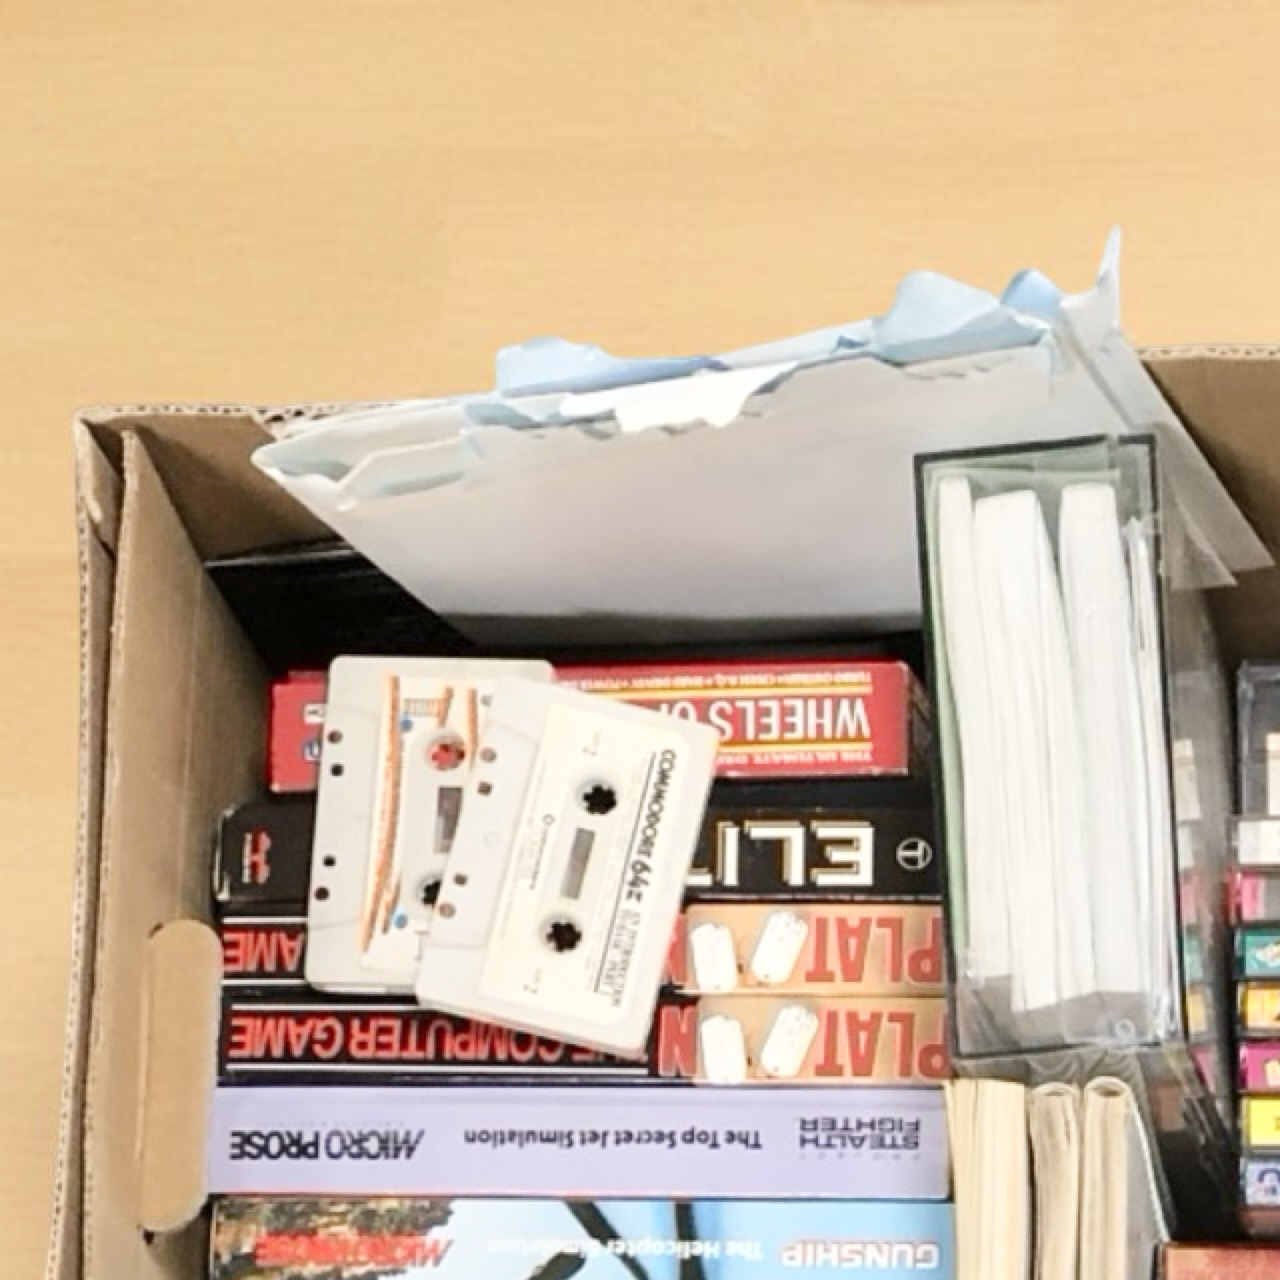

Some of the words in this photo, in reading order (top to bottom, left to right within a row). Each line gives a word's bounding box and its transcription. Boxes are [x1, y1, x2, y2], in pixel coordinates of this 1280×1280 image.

[710, 698, 870, 739] WHEELS
[637, 750, 676, 857] COMMODORE
[690, 821, 874, 886] ELI
[223, 932, 304, 971] AME
[229, 1016, 344, 1058] GAME
[800, 1118, 920, 1133] FIGHTER
[465, 1130, 575, 1149] Simulation
[580, 1130, 611, 1149] Jet
[616, 1130, 677, 1149] Secret
[683, 1126, 724, 1149] Top
[728, 1130, 761, 1149] The
[800, 1135, 920, 1150] STEALTH
[606, 1236, 721, 1259] Helicopter
[727, 1241, 762, 1259] The
[781, 1242, 938, 1268] GUNSHIP
